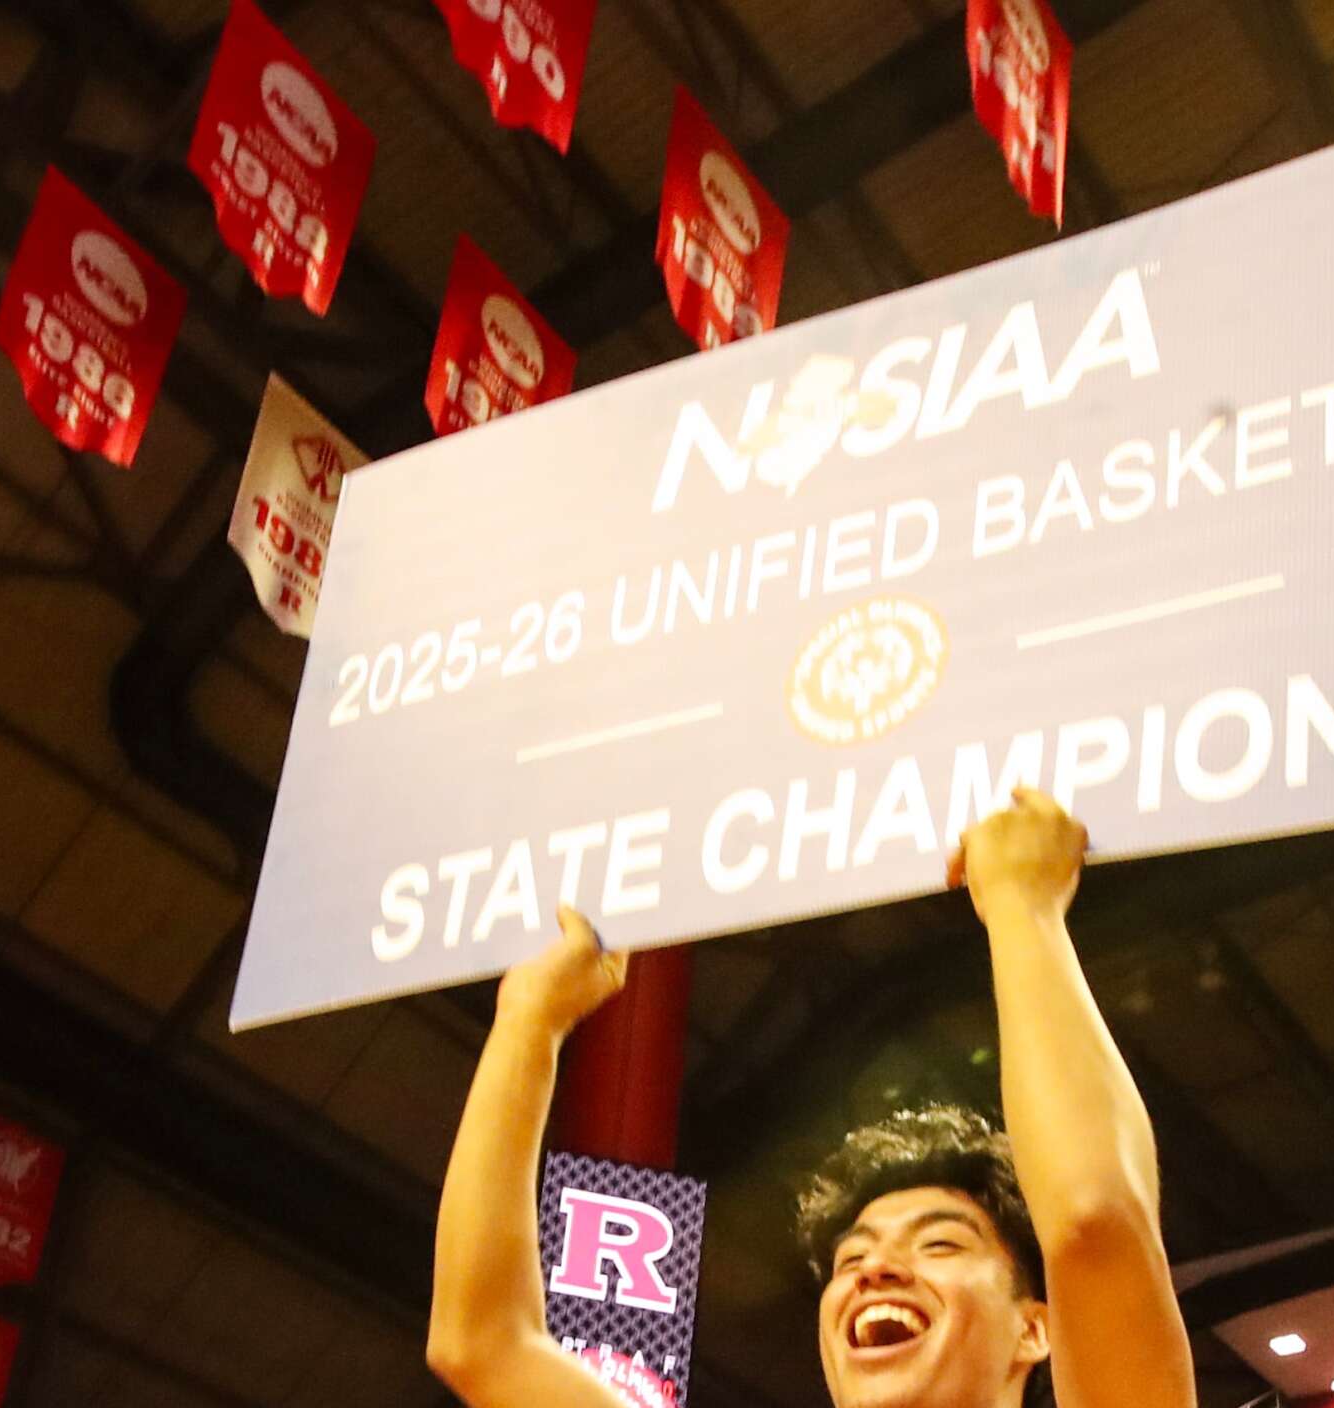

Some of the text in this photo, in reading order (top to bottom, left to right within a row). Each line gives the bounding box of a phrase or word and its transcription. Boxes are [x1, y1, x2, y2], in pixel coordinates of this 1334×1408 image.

[253, 496, 322, 579] 198
[328, 591, 586, 727] 2025-26
[609, 498, 940, 646] UNIFIED
[370, 807, 671, 963] STATE
[550, 1187, 677, 1314] R
